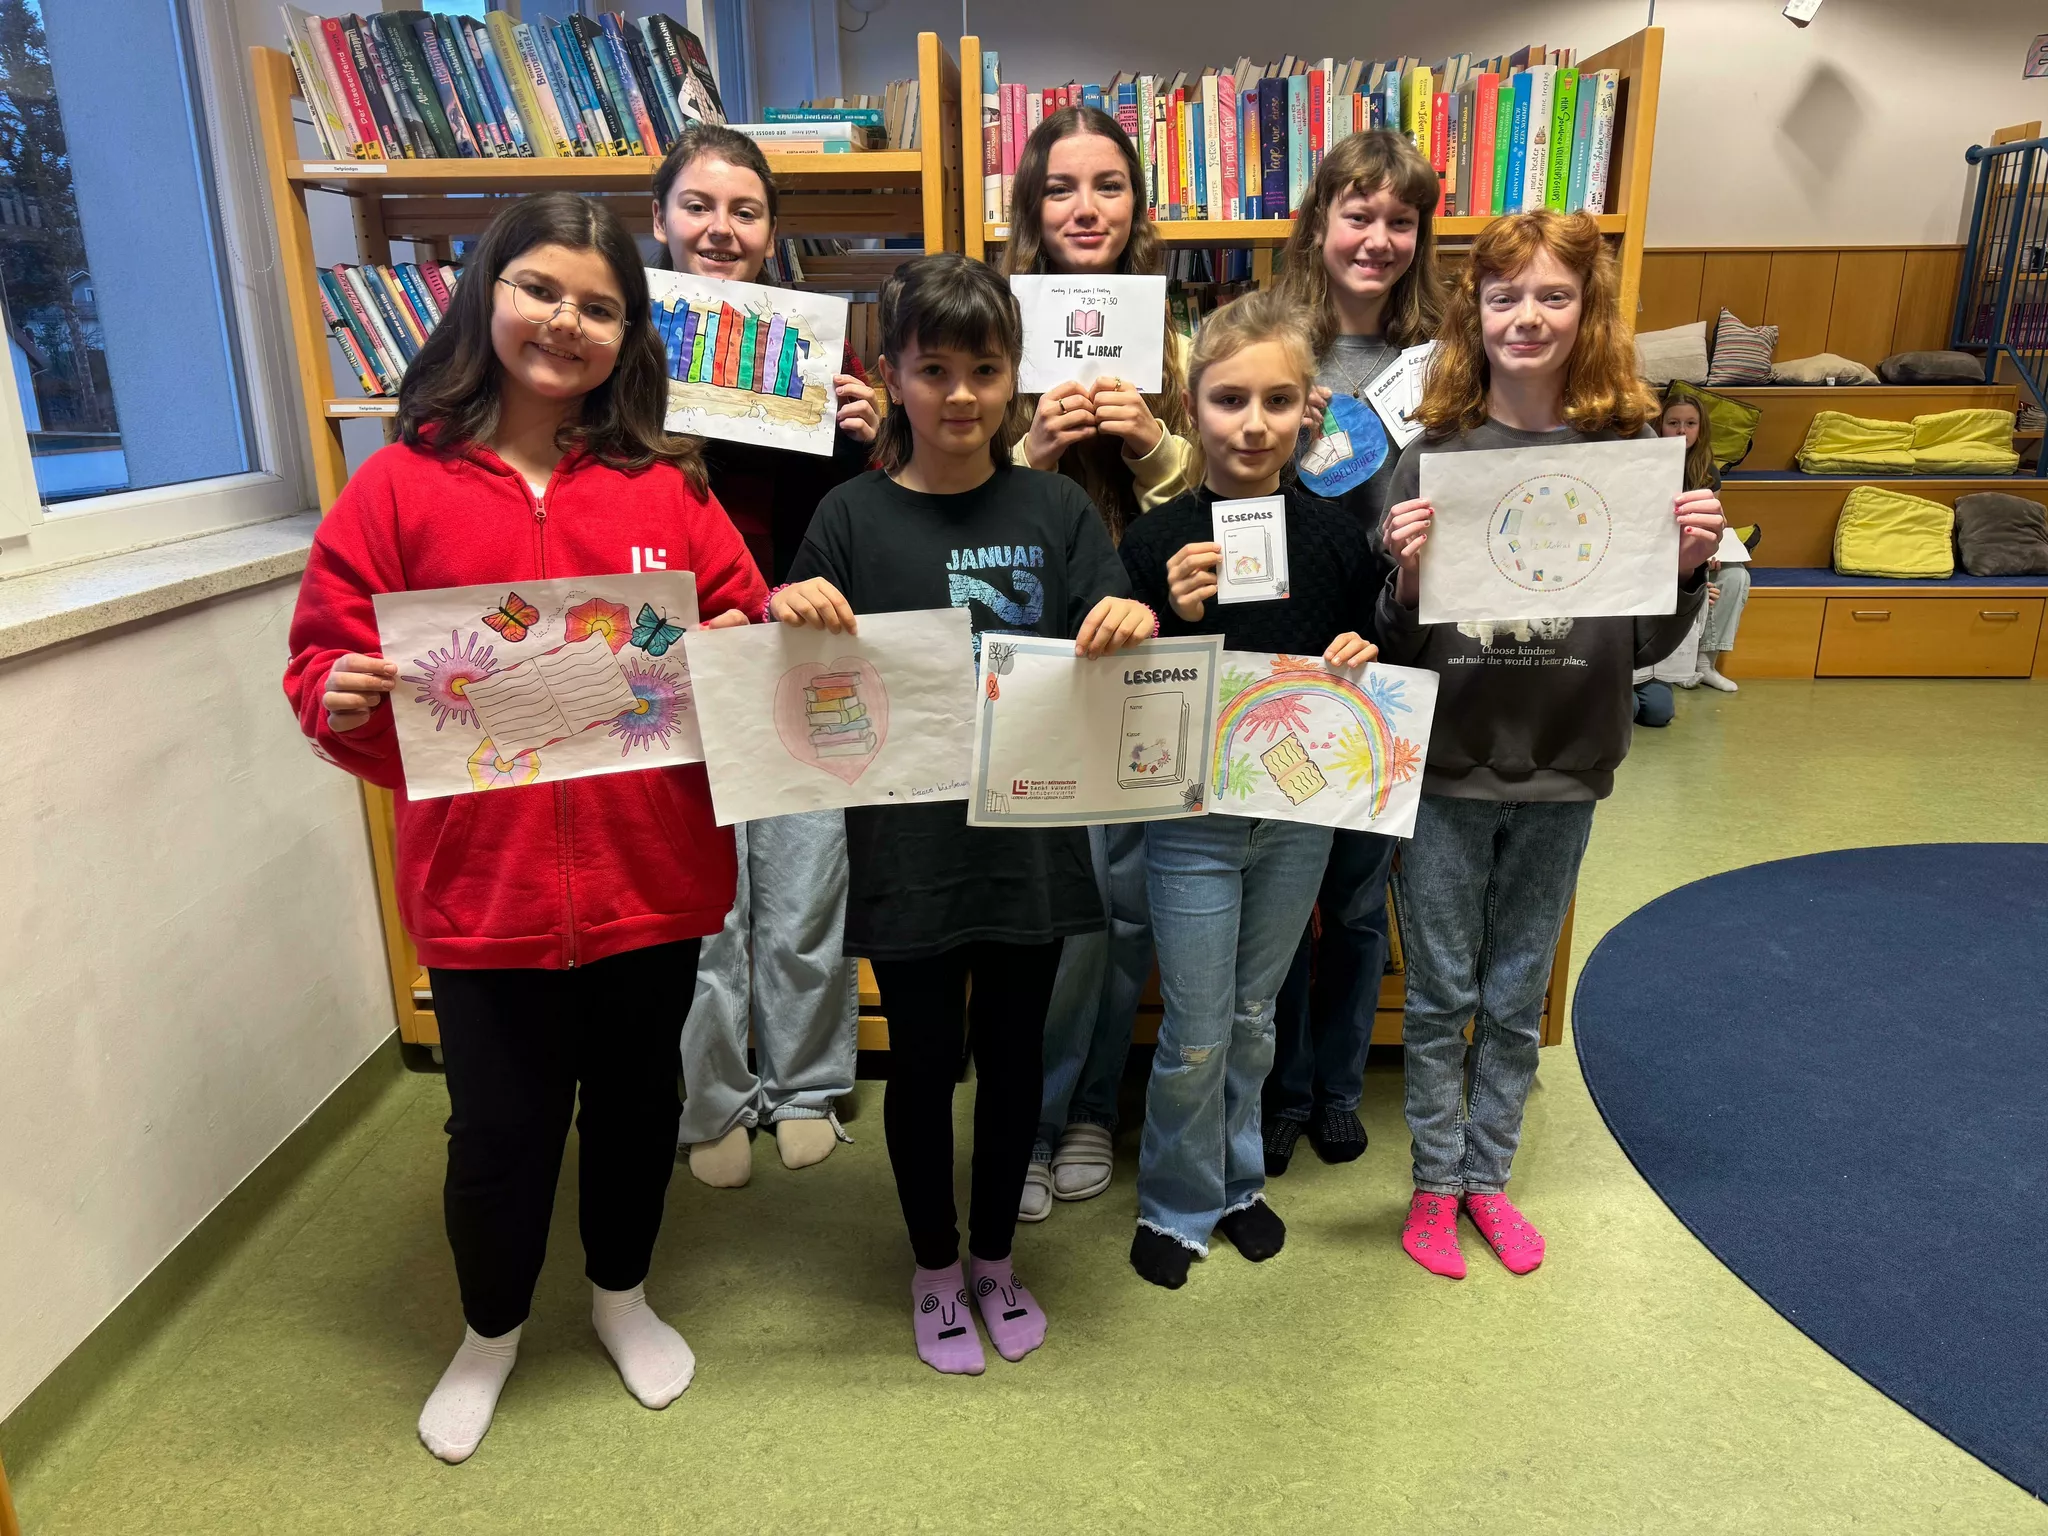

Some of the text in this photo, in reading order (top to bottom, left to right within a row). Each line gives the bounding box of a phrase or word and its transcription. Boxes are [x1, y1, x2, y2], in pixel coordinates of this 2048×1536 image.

[656, 20, 677, 56] HERMANN
[518, 28, 546, 86] BRUDERHERZ
[670, 56, 683, 76] HELD
[336, 51, 361, 107] Klassenfeind
[1541, 71, 1550, 96] freytag
[1141, 78, 1149, 116] NORMAL
[357, 107, 368, 125] Der
[607, 114, 618, 133] CHRIS
[1555, 111, 1570, 145] Sommer
[1223, 115, 1234, 177] Ihr mich auch
[1264, 96, 1284, 178] Tage wie diese
[1530, 147, 1539, 171] bester
[1591, 161, 1601, 181] Mein
[1534, 178, 1543, 202] letzter
[401, 272, 415, 294] David
[412, 294, 422, 308] bin
[1053, 340, 1123, 358] THE LIBRARY
[1322, 449, 1378, 487] BIBELIOTHEK
[1221, 511, 1273, 524] LESEPASS
[946, 545, 1044, 571] JANUAR
[1448, 656, 1464, 664] and
[1466, 656, 1485, 664] make
[1487, 656, 1502, 665] the
[1504, 657, 1532, 666] world
[1542, 657, 1561, 666] better
[1562, 656, 1589, 667] place.
[1482, 645, 1556, 655] Choose kindness
[1124, 668, 1198, 685] LESEPASS
